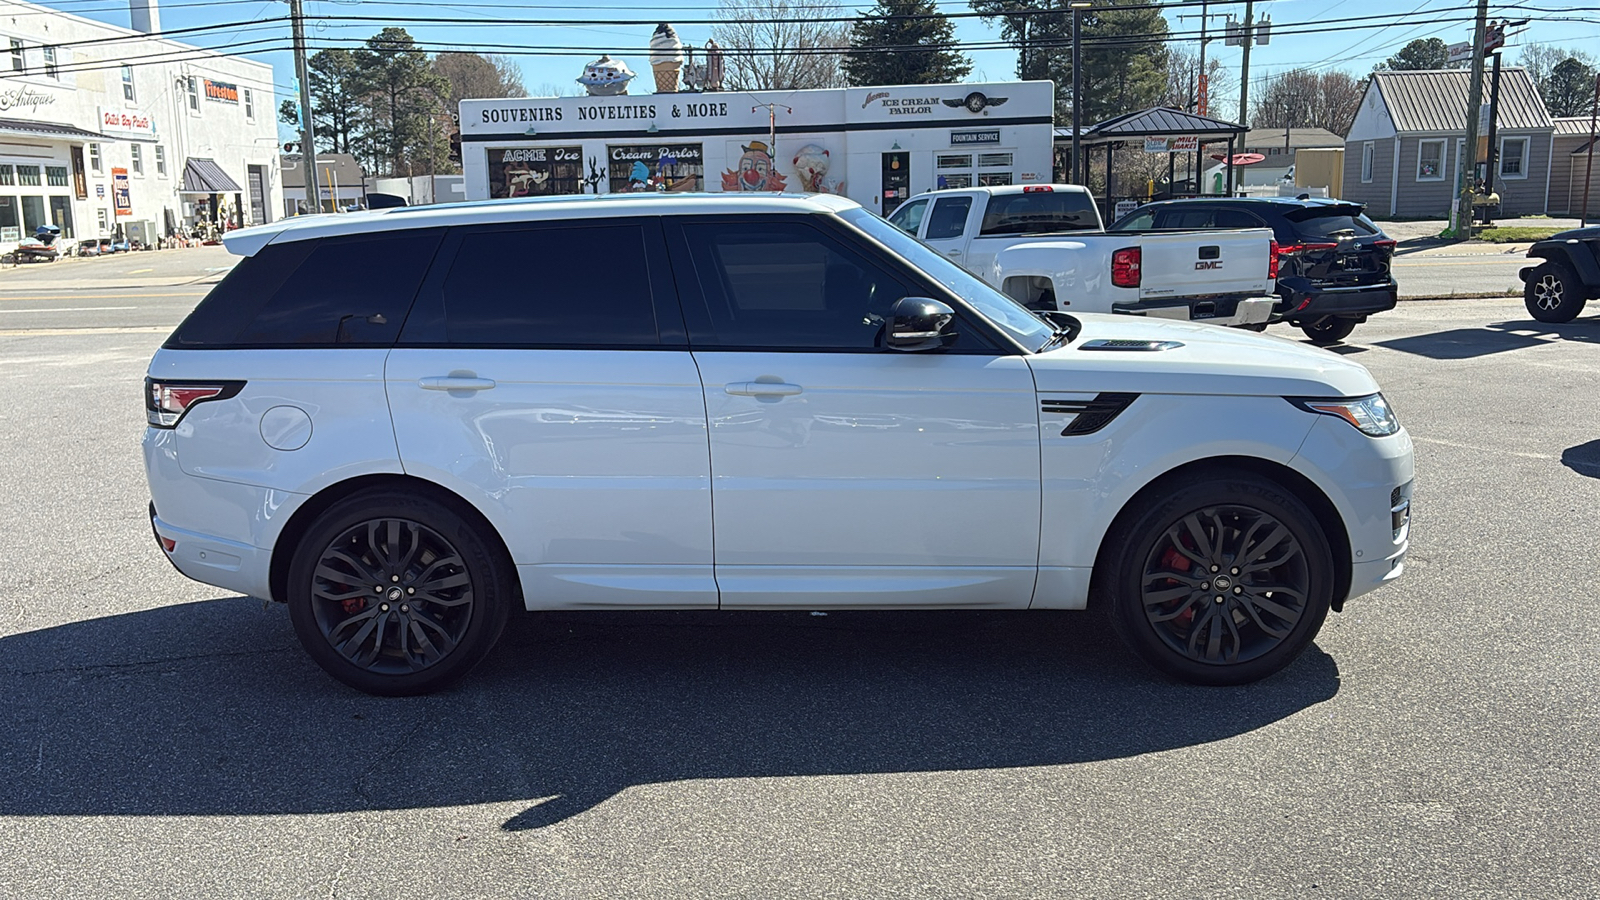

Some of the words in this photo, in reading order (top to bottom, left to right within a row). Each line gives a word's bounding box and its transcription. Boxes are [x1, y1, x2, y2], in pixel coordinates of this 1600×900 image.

[204, 79, 238, 101] Firestone
[5, 84, 56, 113] Antiques
[882, 99, 899, 107] ICE
[901, 98, 940, 106] CREAM
[481, 107, 563, 123] SOUVENIRS
[578, 105, 656, 120] NOVELTIES
[671, 104, 681, 118] &
[687, 103, 728, 117] MORE
[889, 106, 932, 114] PARLOR
[104, 112, 119, 125] Dutch
[121, 114, 132, 130] Boy
[132, 115, 149, 129] Paints
[953, 134, 977, 142] FOUNTAIN
[978, 133, 998, 141] SERVICE
[503, 149, 547, 162] ACME
[554, 148, 580, 160] Ice
[612, 148, 653, 160] Cream
[658, 147, 700, 160] Parlor
[1195, 261, 1222, 270] GMC
